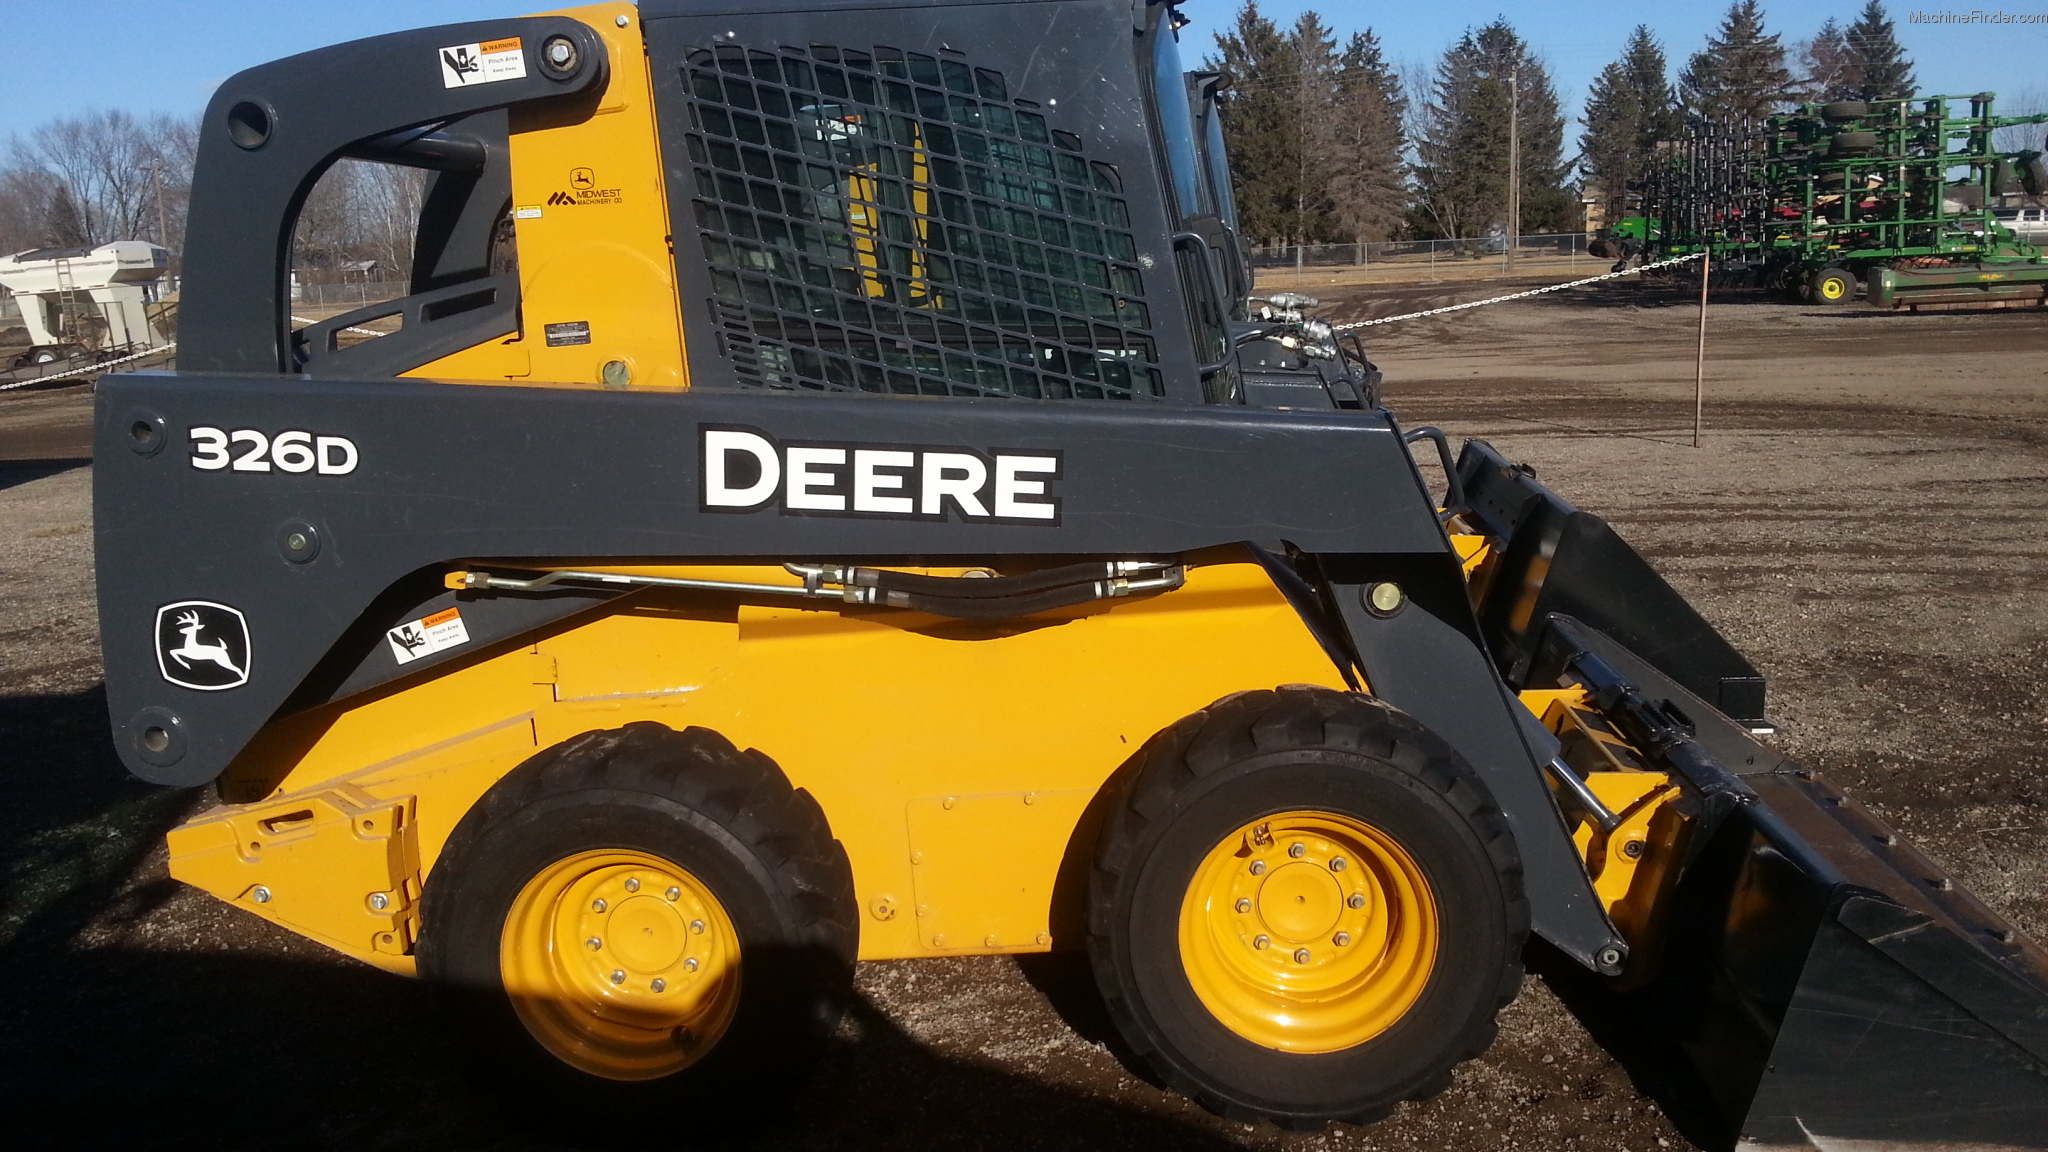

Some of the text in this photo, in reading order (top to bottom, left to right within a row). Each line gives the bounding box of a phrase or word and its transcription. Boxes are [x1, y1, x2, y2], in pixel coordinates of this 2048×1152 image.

[488, 41, 518, 51] WARNING
[488, 57, 504, 65] Pinch
[576, 188, 622, 199] MIDWEST
[577, 198, 612, 206] MACHINERY
[190, 426, 359, 475] 326D
[705, 430, 1057, 520] DEERE
[429, 611, 456, 624] WARNING
